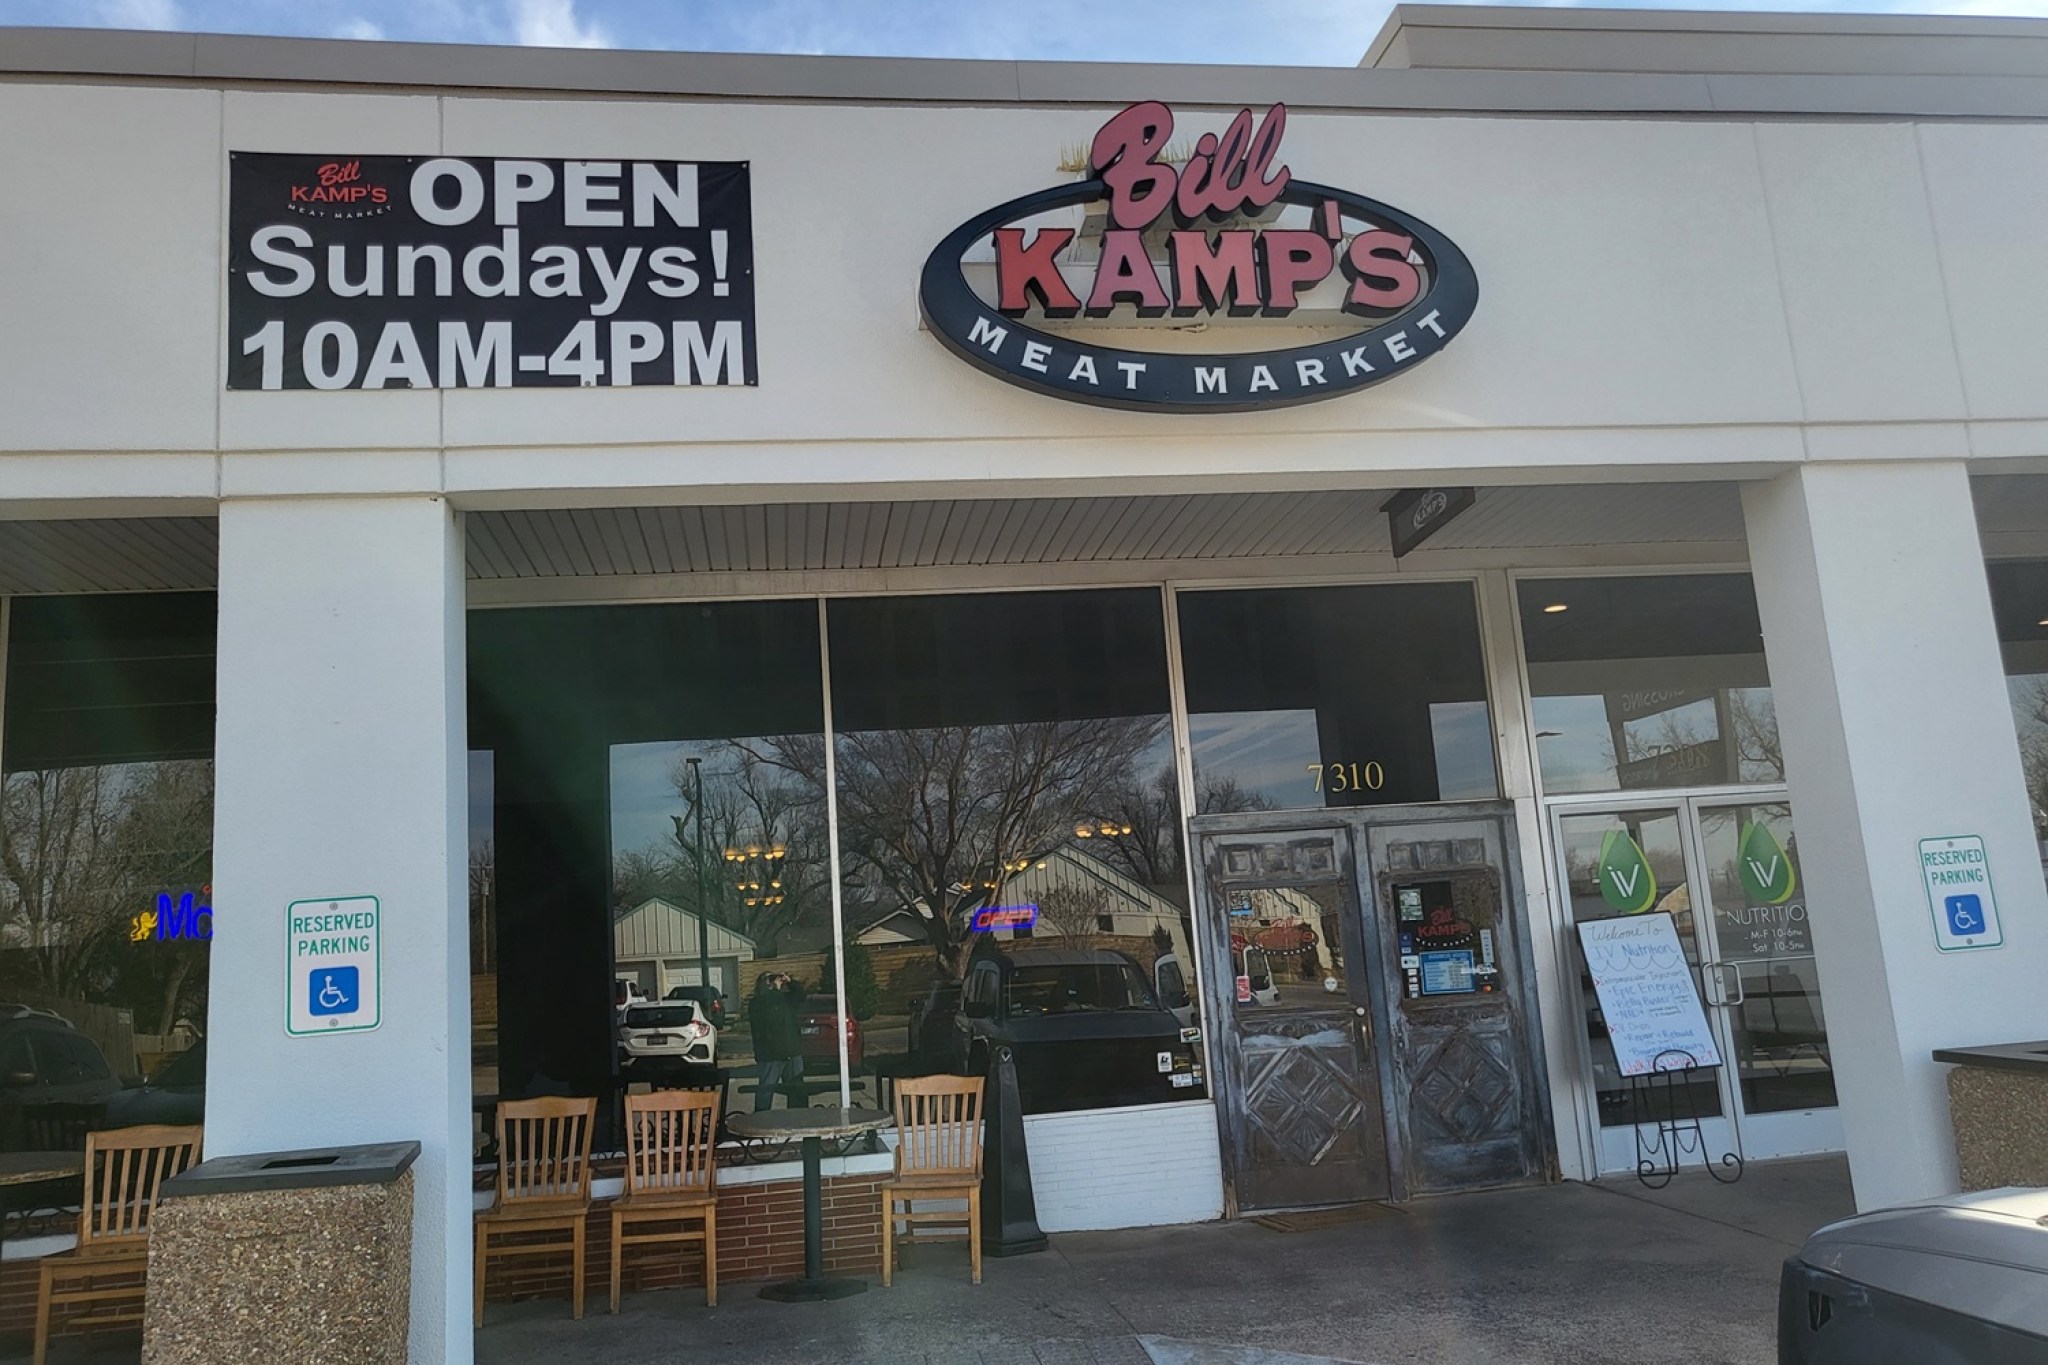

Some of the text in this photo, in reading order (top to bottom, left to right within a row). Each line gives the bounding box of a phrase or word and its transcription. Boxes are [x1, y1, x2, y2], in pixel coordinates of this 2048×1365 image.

[317, 160, 361, 187] Bill
[1091, 101, 1291, 230] Bill
[290, 184, 388, 203] KAMP'S
[410, 158, 700, 227] OPEN
[287, 204, 391, 219] MEAT MARKET
[994, 201, 1422, 312] KAMP'S
[246, 224, 731, 317] Sundays!
[242, 320, 745, 391] 10AM-4PM
[967, 309, 1446, 394] MEAT MARKET
[1307, 761, 1384, 793] 7310
[1924, 848, 1982, 866] RESERVED
[1931, 868, 1984, 886] PARKING
[293, 912, 375, 934] RESERVED
[977, 908, 1034, 929] OPEN
[1726, 904, 1805, 926] NUTRITIO
[1587, 924, 1643, 941] Welcome
[298, 935, 370, 957] PARKING
[1621, 942, 1677, 957] Nutrition
[1752, 942, 1767, 953] Sat
